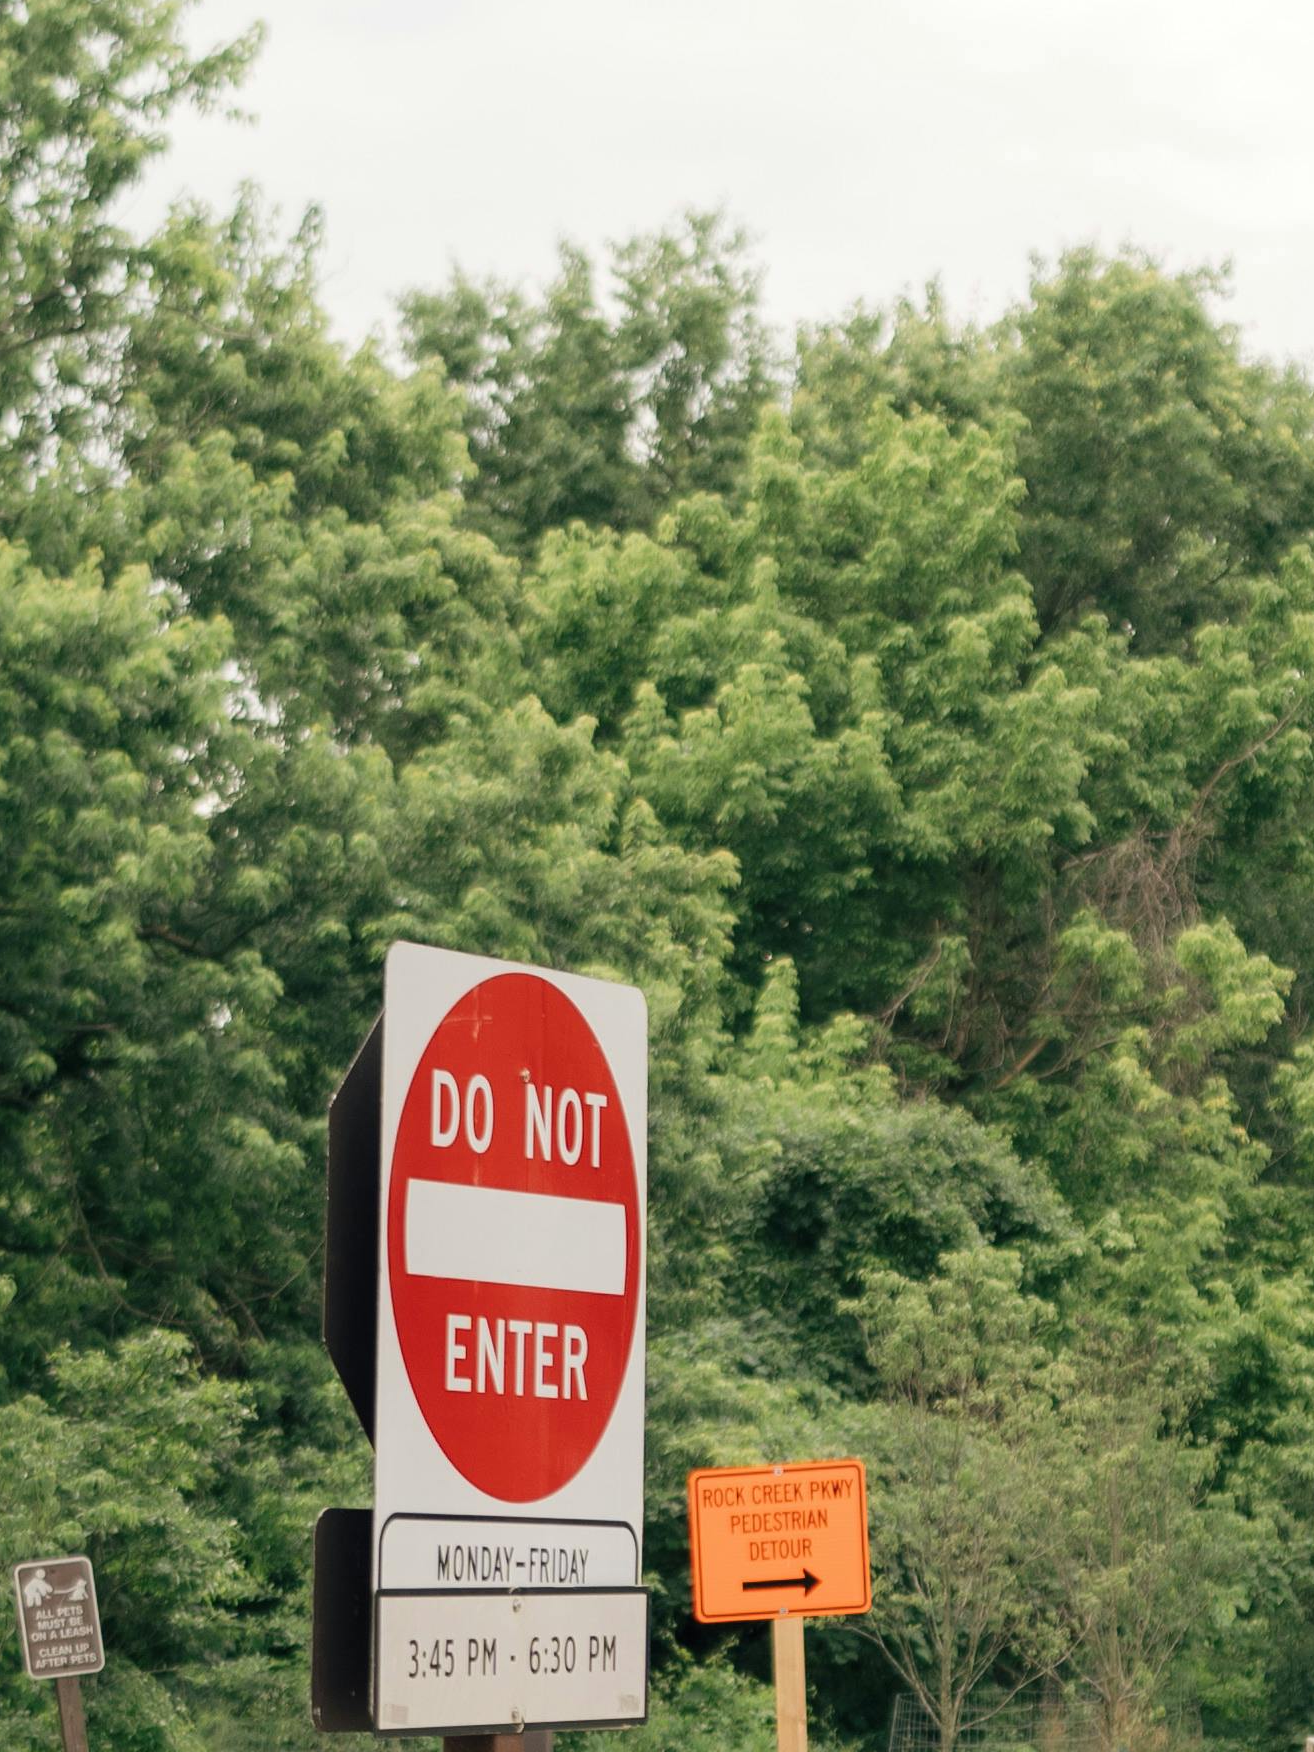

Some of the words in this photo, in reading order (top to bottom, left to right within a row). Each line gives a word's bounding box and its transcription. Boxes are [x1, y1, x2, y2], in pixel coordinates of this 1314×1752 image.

[431, 1068, 494, 1154] DO
[525, 1082, 608, 1168] NOT
[445, 1313, 589, 1401] ENTER
[703, 1487, 746, 1508] ROCK
[751, 1482, 804, 1505] CREEK
[809, 1478, 854, 1501] PKWY
[730, 1509, 828, 1535] PEDESTRIAN
[748, 1538, 813, 1562] DETOUR
[437, 1544, 590, 1585] MONDAY-FRIDAY
[36, 1609, 54, 1620] ALL
[57, 1605, 83, 1617] PETS
[37, 1618, 66, 1630] MUST
[70, 1616, 83, 1626] BE
[31, 1632, 47, 1642] ON
[50, 1630, 58, 1640] A
[60, 1625, 94, 1639] LEASH
[35, 1657, 68, 1669] AFTER
[69, 1653, 96, 1664] PETS
[39, 1645, 72, 1657] CLEAN
[76, 1643, 89, 1653] UP
[408, 1639, 456, 1679] 3:45
[467, 1637, 497, 1676] PM
[529, 1636, 577, 1675] 6:30
[588, 1635, 617, 1673] PM
